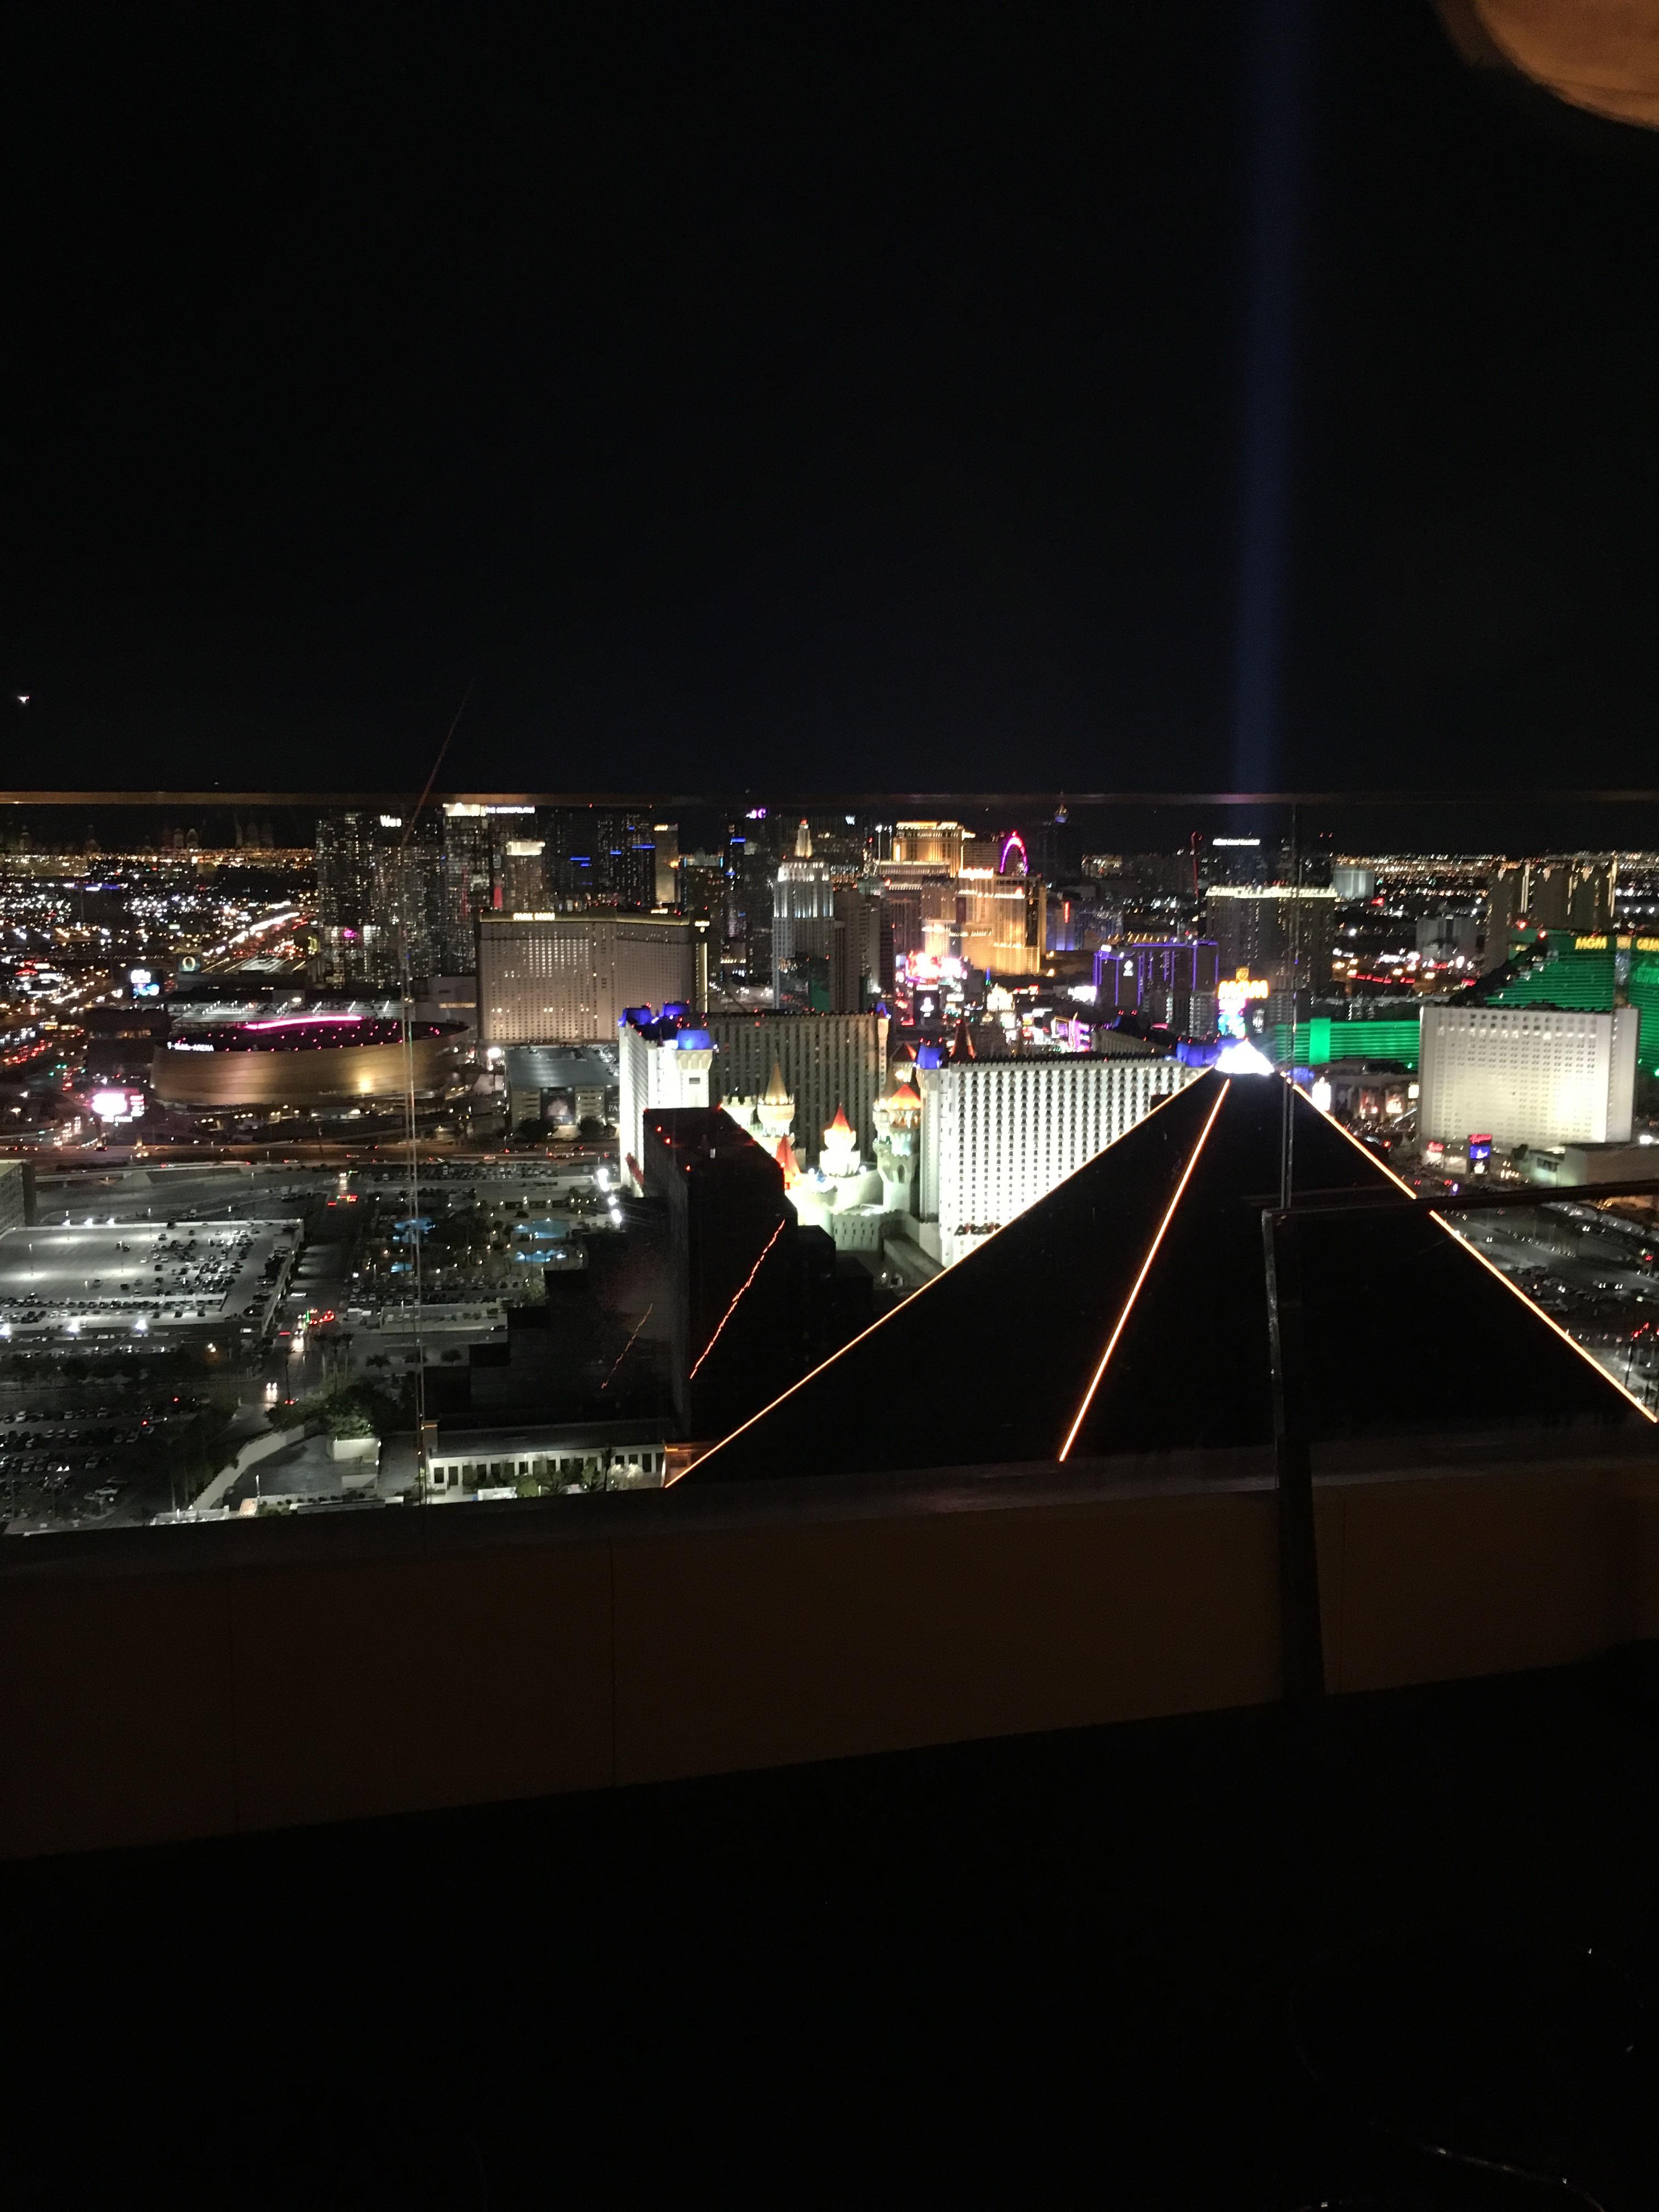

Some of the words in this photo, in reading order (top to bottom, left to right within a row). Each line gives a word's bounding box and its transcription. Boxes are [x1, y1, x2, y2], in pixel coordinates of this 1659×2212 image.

[514, 912, 533, 921] PARK
[534, 912, 555, 921] MGM
[1575, 935, 1608, 950] MGM
